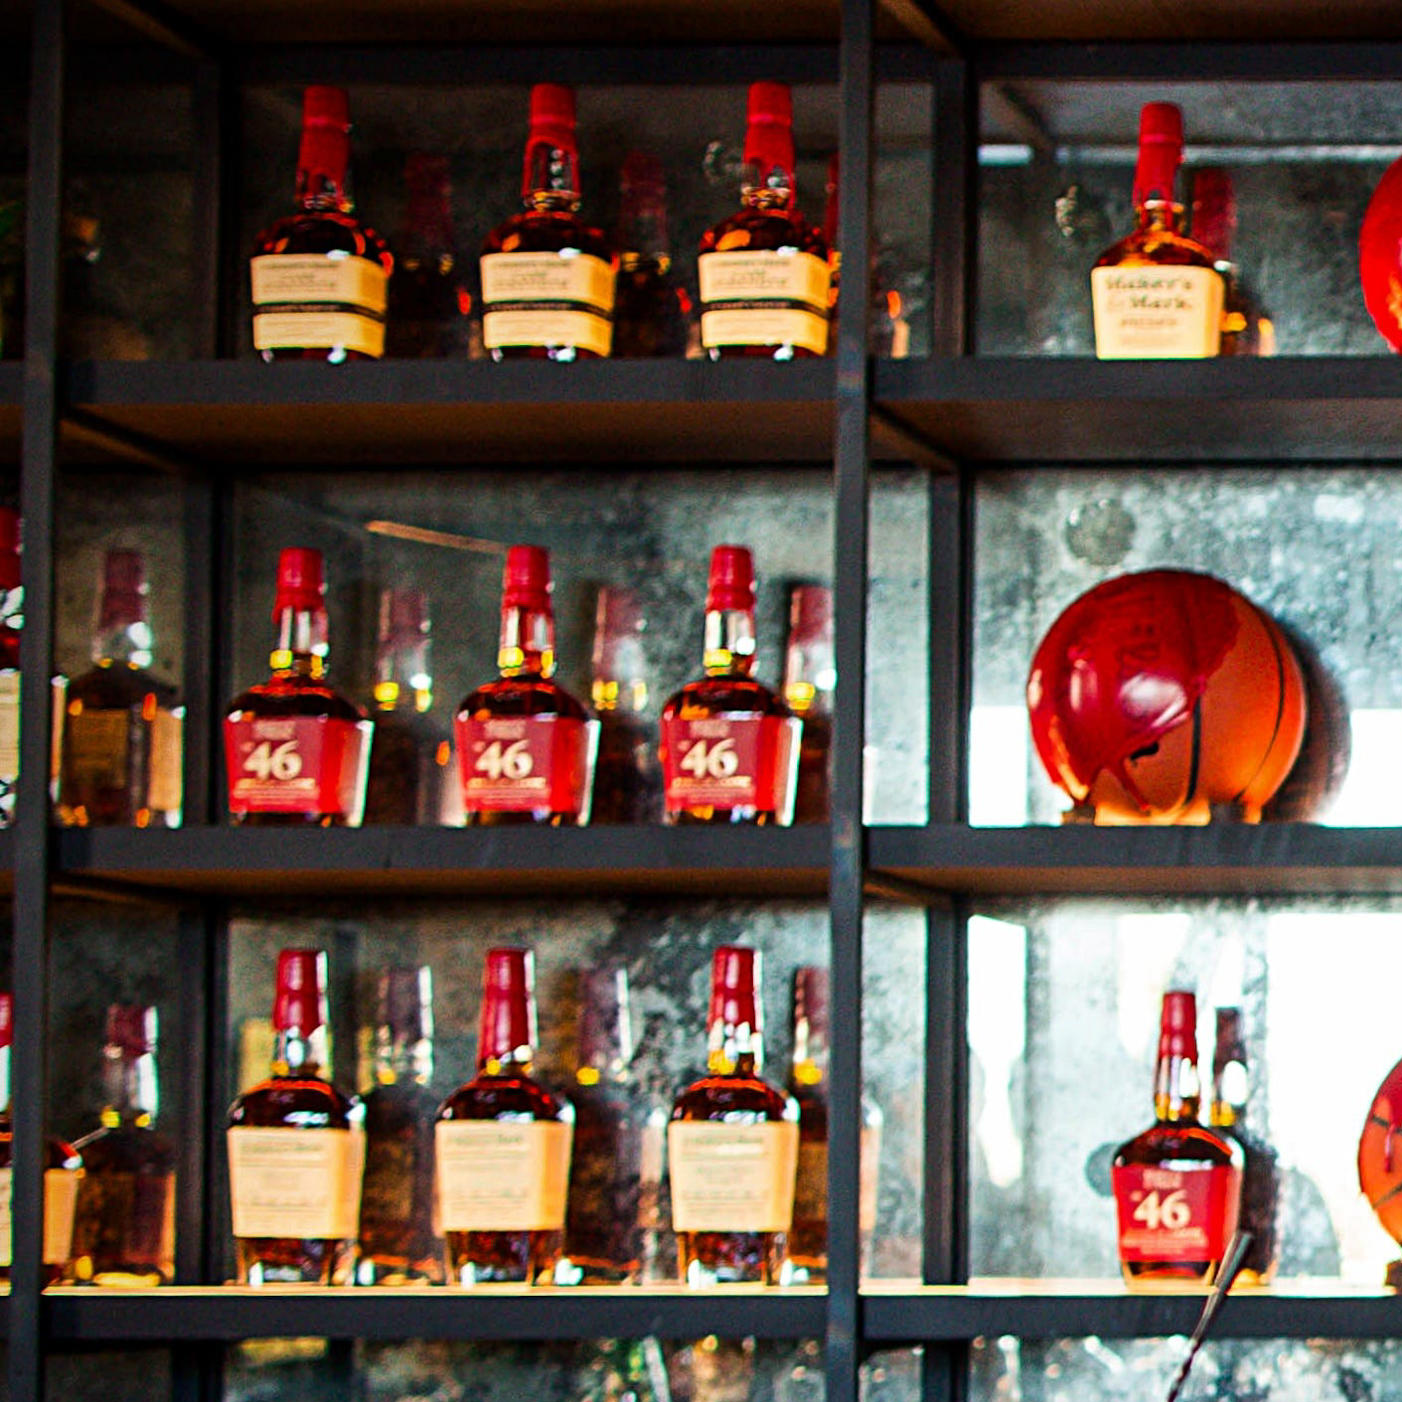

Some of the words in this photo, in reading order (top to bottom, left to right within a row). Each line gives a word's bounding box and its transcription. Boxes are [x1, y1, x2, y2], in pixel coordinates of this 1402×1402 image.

[243, 741, 301, 780] 46
[475, 739, 533, 779] 46
[680, 738, 738, 778] 46
[1133, 1189, 1191, 1230] 46
